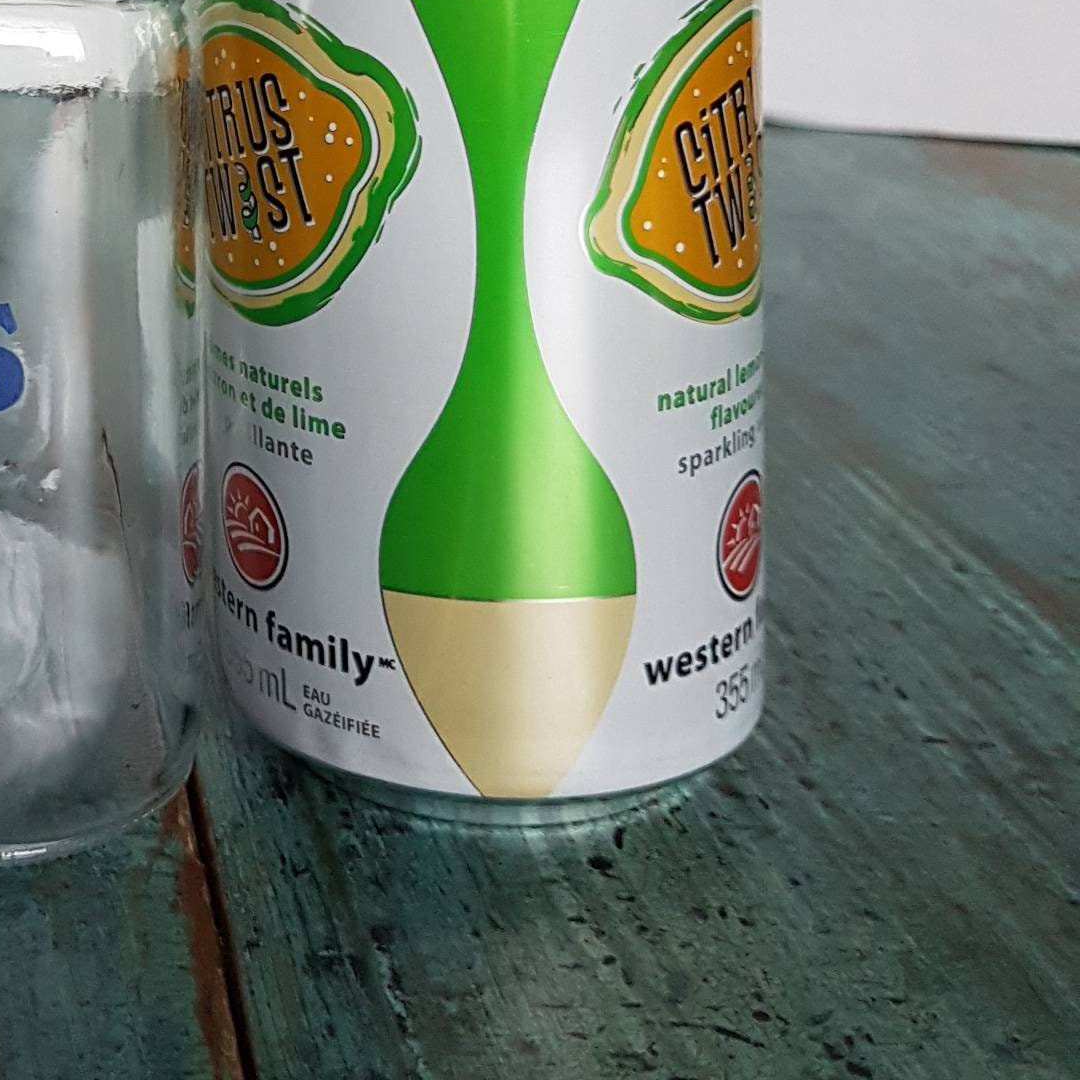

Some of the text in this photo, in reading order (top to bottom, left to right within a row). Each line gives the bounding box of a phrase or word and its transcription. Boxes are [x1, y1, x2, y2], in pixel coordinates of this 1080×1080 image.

[240, 360, 323, 402] naturels
[657, 367, 731, 412] natural
[240, 390, 256, 413] et
[261, 396, 285, 424] de
[292, 405, 346, 439] lime
[678, 425, 755, 477] sparkling
[643, 616, 752, 686] western
[303, 684, 330, 706] EAU
[304, 703, 381, 739] GAZÉIFIÉE
